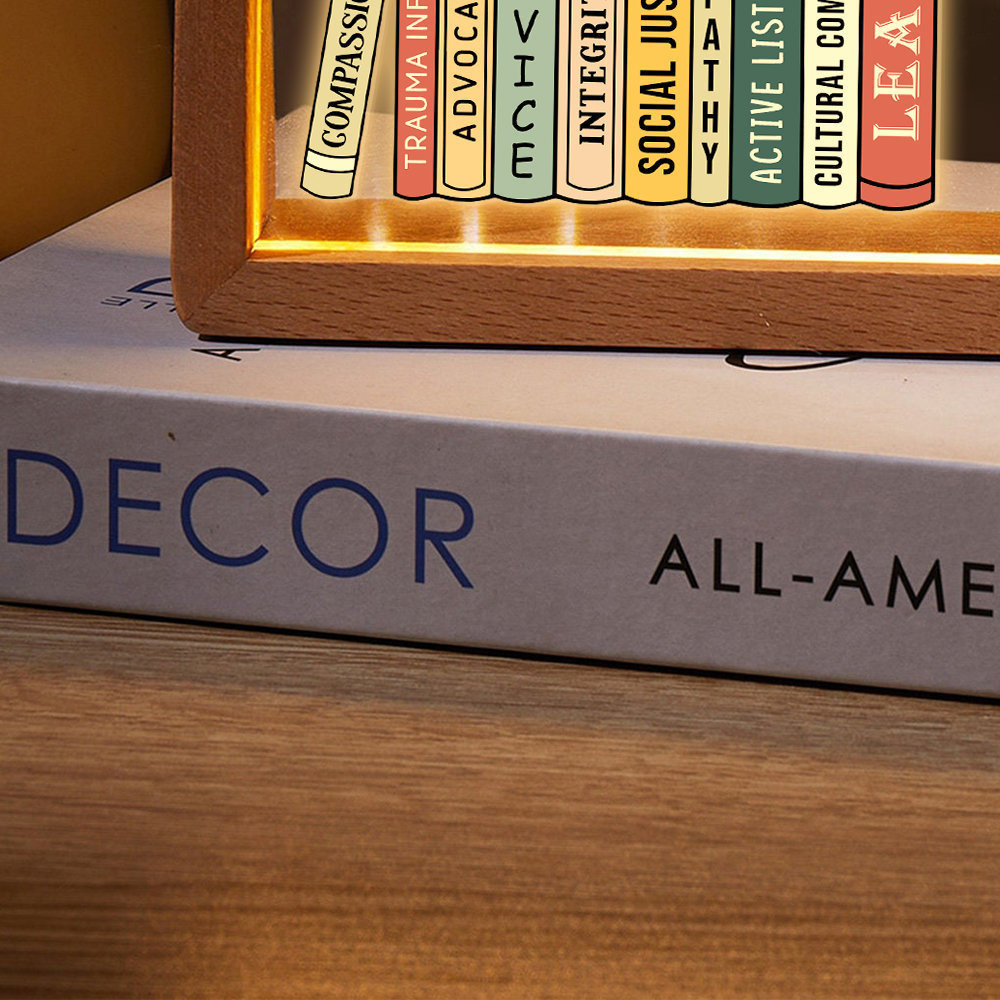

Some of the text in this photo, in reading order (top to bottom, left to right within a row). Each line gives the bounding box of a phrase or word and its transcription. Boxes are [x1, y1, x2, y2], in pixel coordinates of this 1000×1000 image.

[404, 51, 429, 170] TRAUMA
[637, 61, 677, 176] SOCIAL
[749, 81, 784, 184] ACTIVE
[814, 59, 844, 187] CULTURAL
[7, 449, 474, 589] DECOR
